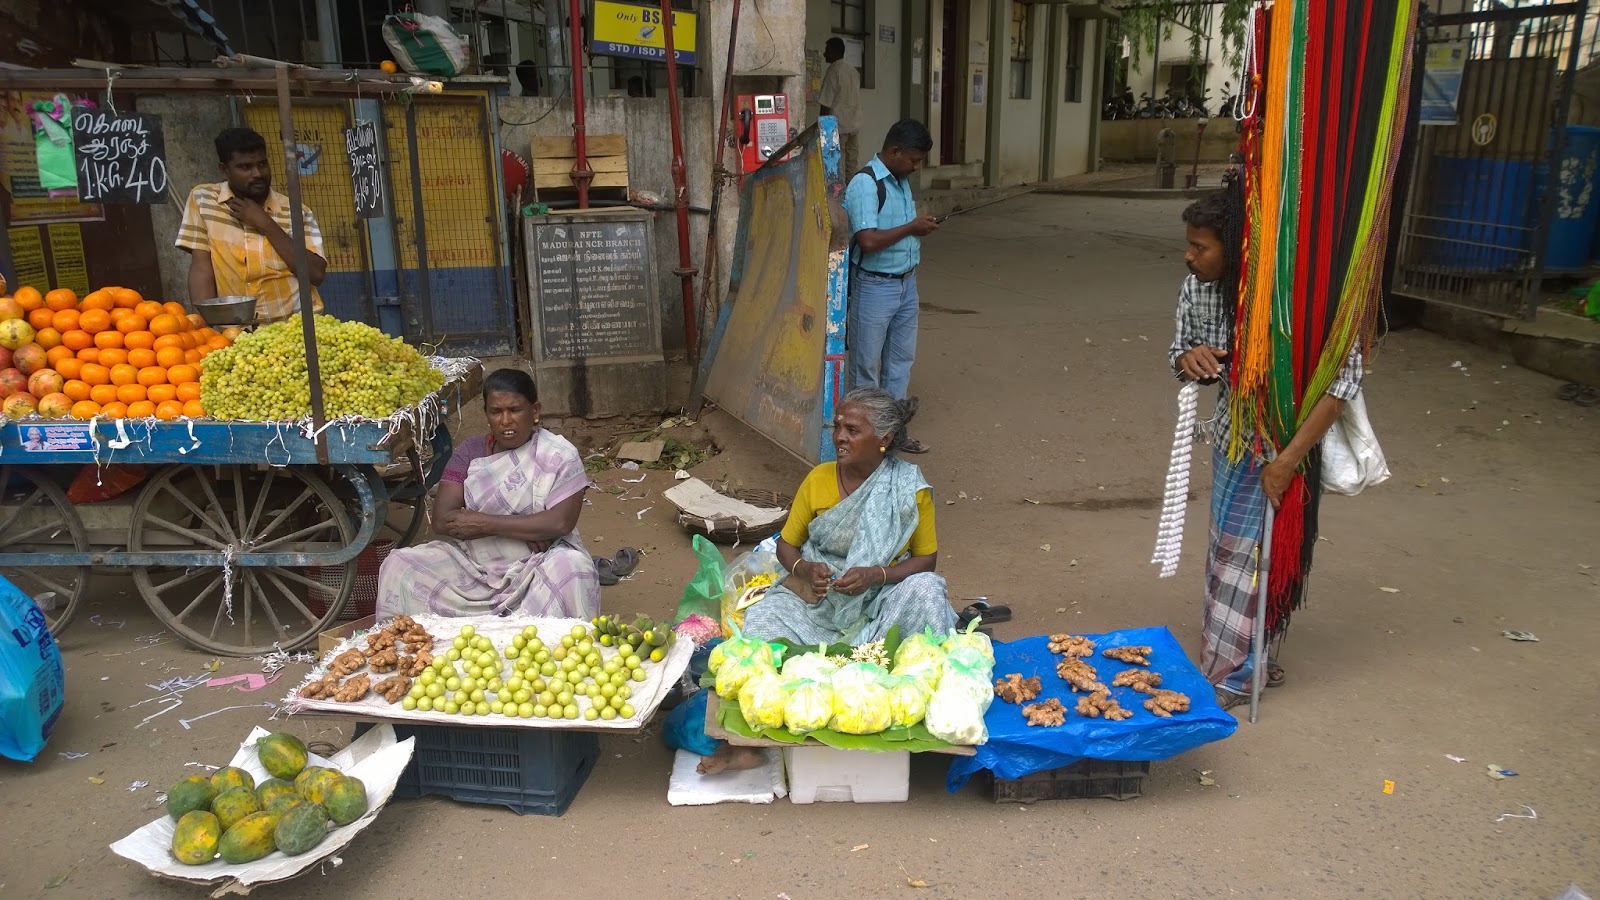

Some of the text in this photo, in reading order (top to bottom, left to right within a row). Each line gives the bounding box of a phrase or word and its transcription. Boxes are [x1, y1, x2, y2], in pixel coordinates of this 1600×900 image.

[616, 9, 677, 26] Only BSL
[609, 43, 630, 53] STD
[639, 46, 656, 56] ISD
[659, 49, 680, 59] PO
[501, 148, 512, 157] TY
[124, 156, 166, 203] 40
[580, 231, 602, 239] NFTE
[542, 239, 641, 249] MADURAI NCR BRANCH
